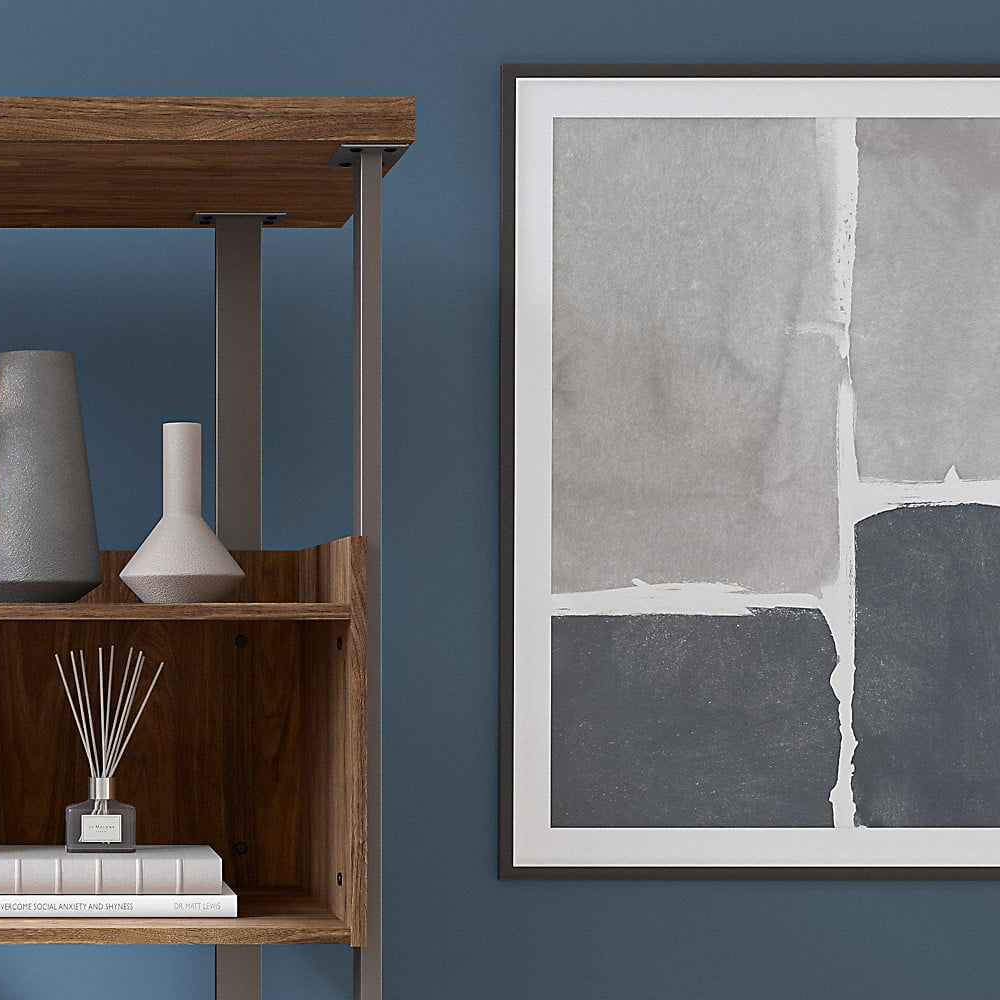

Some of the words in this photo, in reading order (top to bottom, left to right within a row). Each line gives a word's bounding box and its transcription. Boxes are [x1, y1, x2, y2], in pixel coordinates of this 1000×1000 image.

[33, 903, 58, 911] SOCIAL
[58, 903, 87, 911] ANXIETY
[88, 903, 104, 911] AND
[105, 903, 134, 911] SHYNESS
